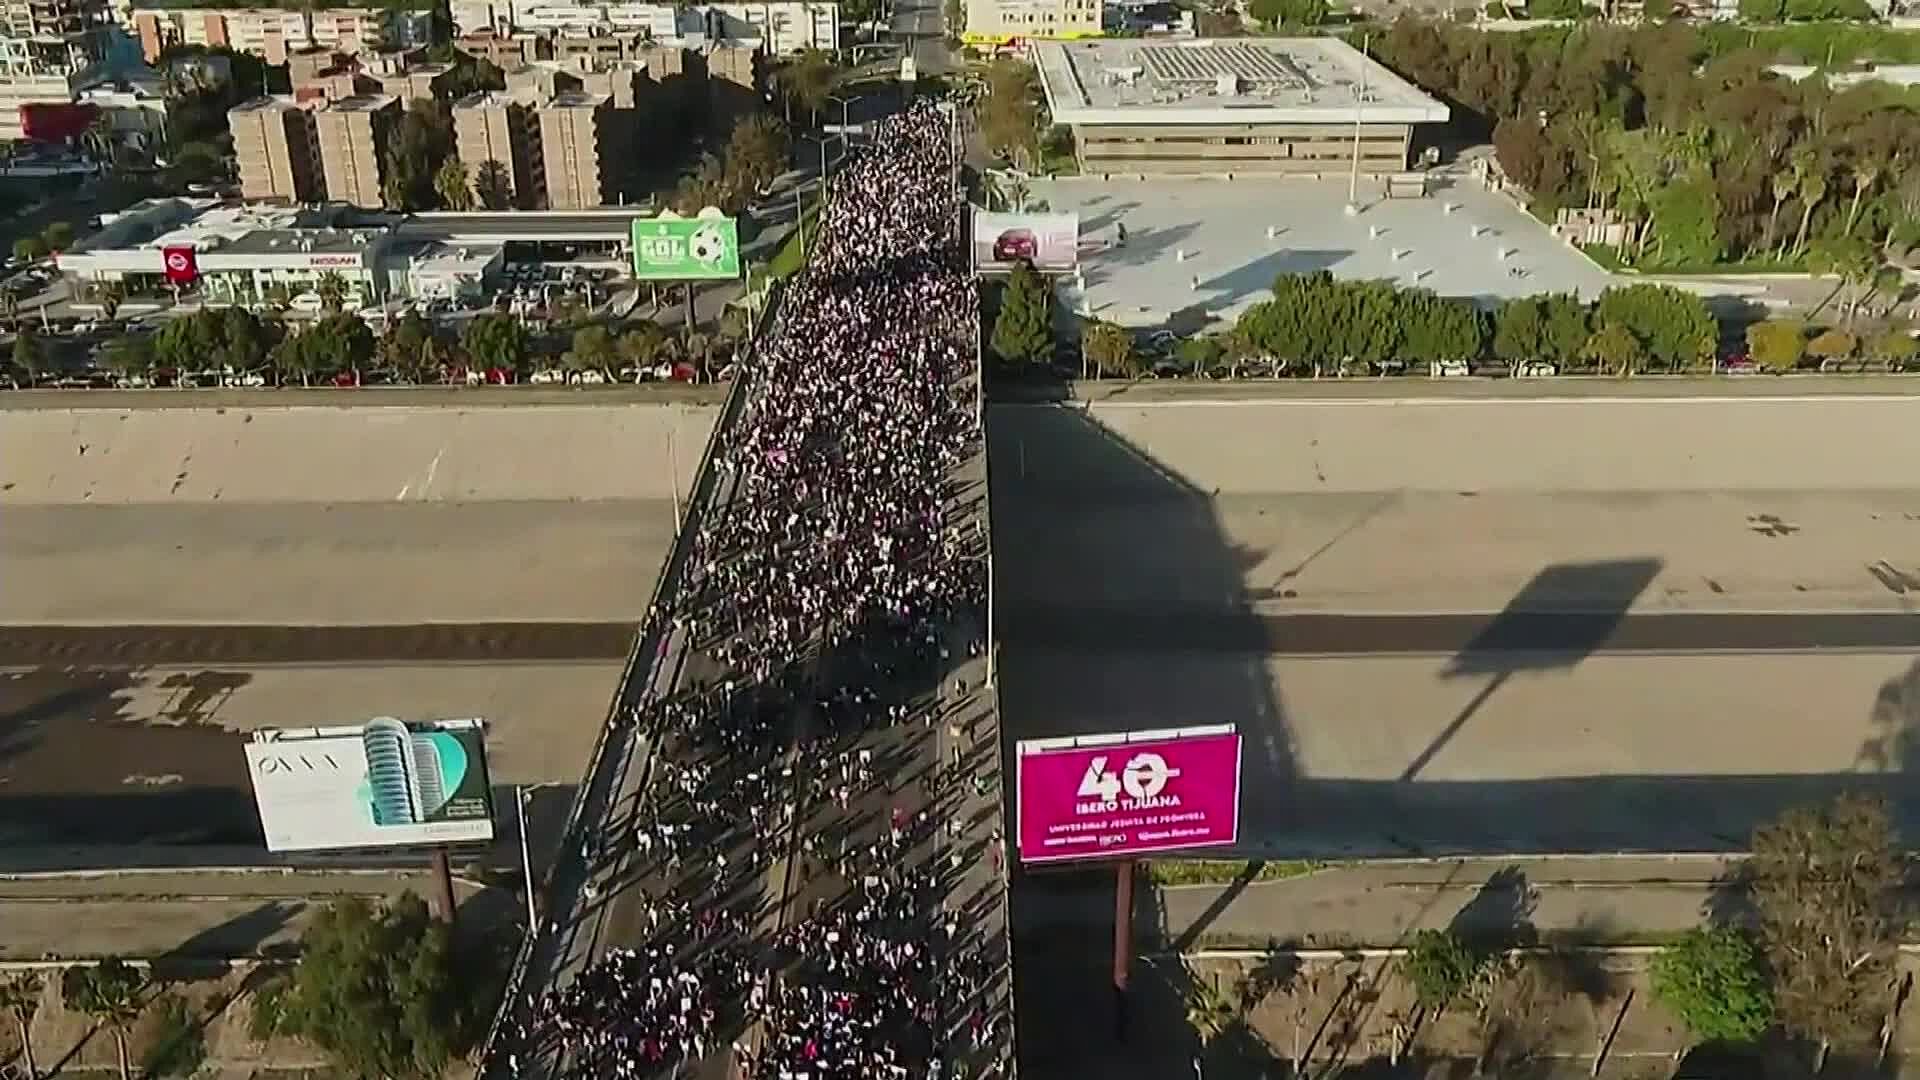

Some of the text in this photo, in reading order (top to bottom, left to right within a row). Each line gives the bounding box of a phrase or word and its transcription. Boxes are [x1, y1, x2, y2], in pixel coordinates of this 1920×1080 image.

[310, 257, 356, 265] NISSAN
[1076, 795, 1181, 815] IBERO TIJUANA
